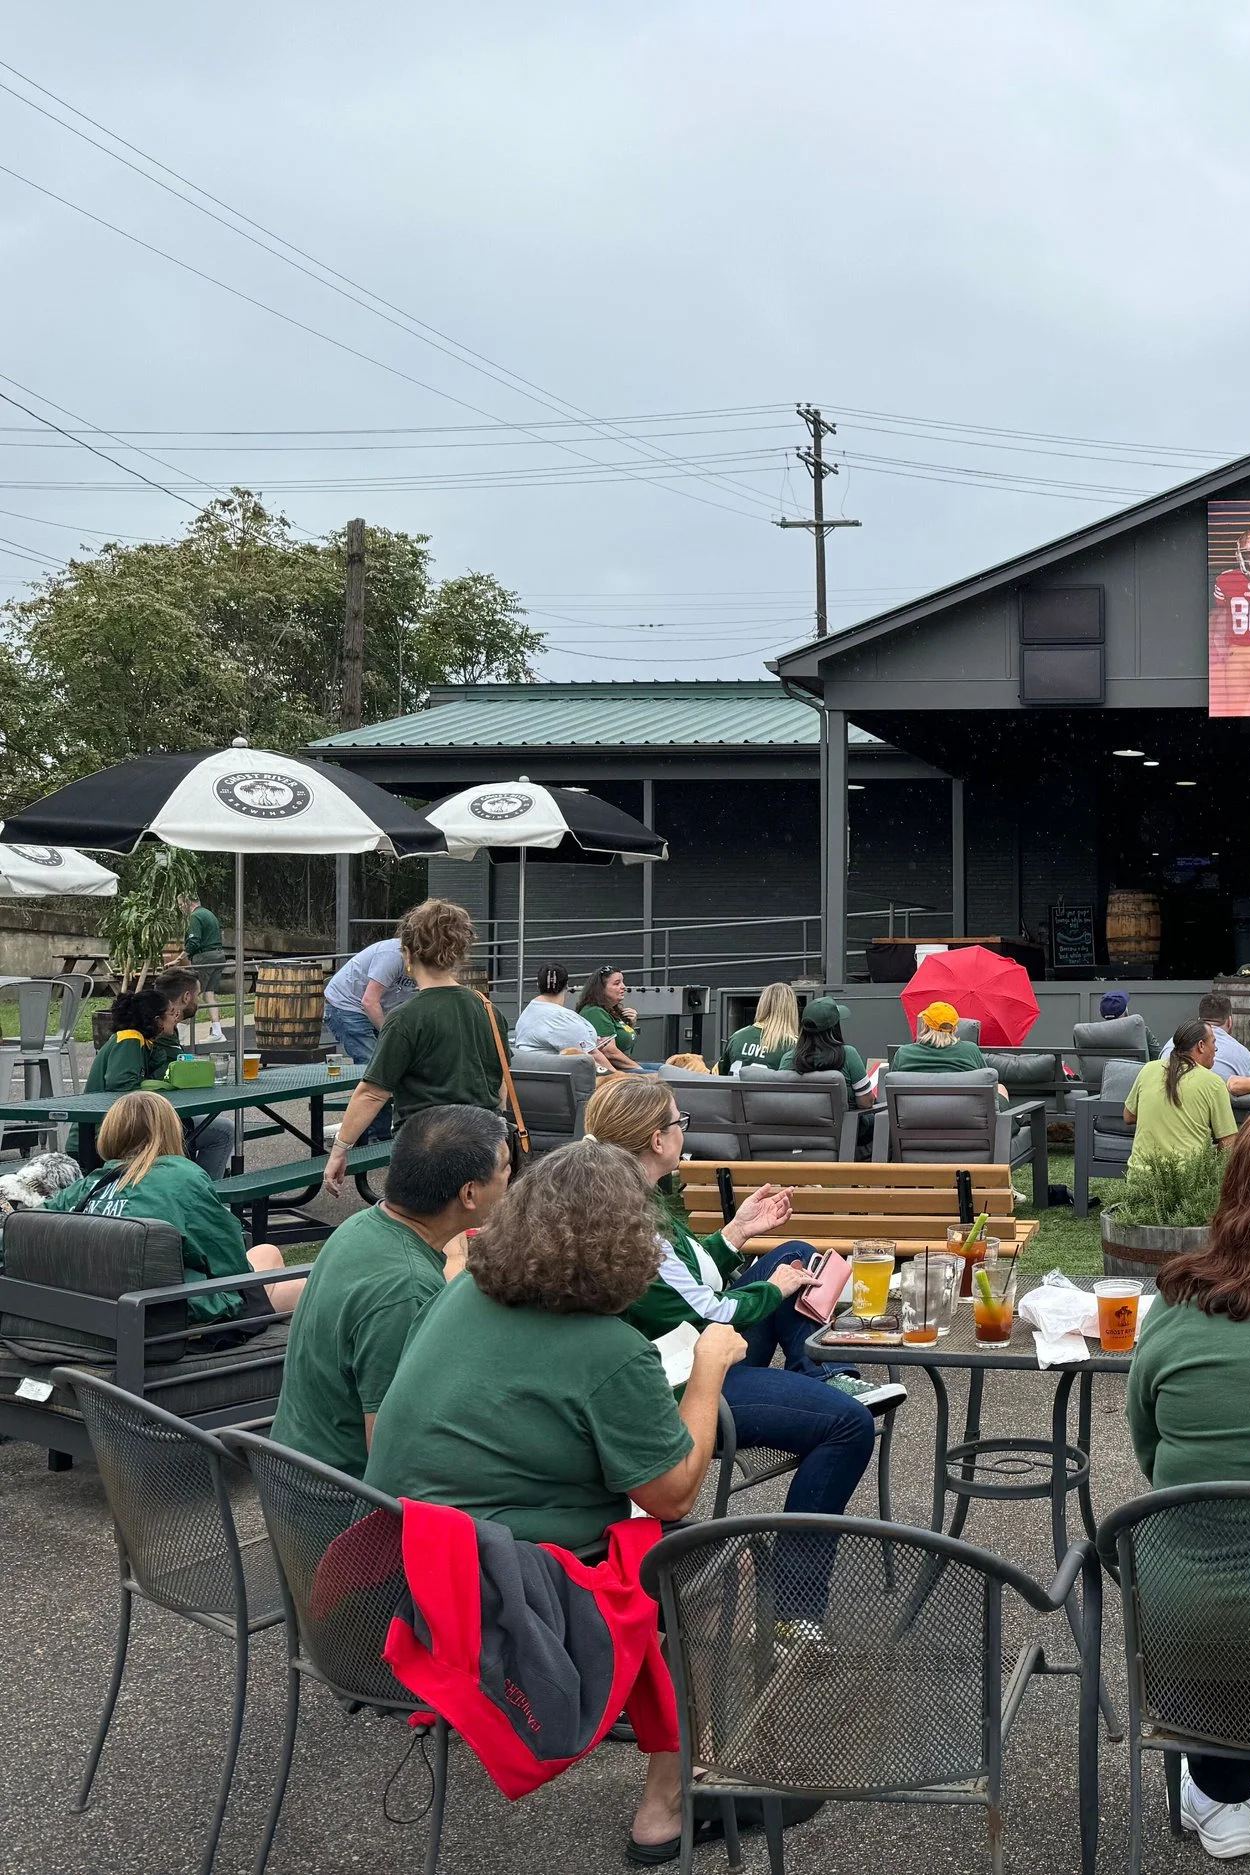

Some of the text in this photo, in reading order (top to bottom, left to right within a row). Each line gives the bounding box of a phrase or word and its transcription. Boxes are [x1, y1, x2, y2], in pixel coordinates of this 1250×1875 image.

[223, 773, 298, 788] GHOST RIVER
[228, 798, 304, 816] BREWING CO.
[741, 1042, 767, 1059] LOVE
[102, 1199, 129, 1217] BAY
